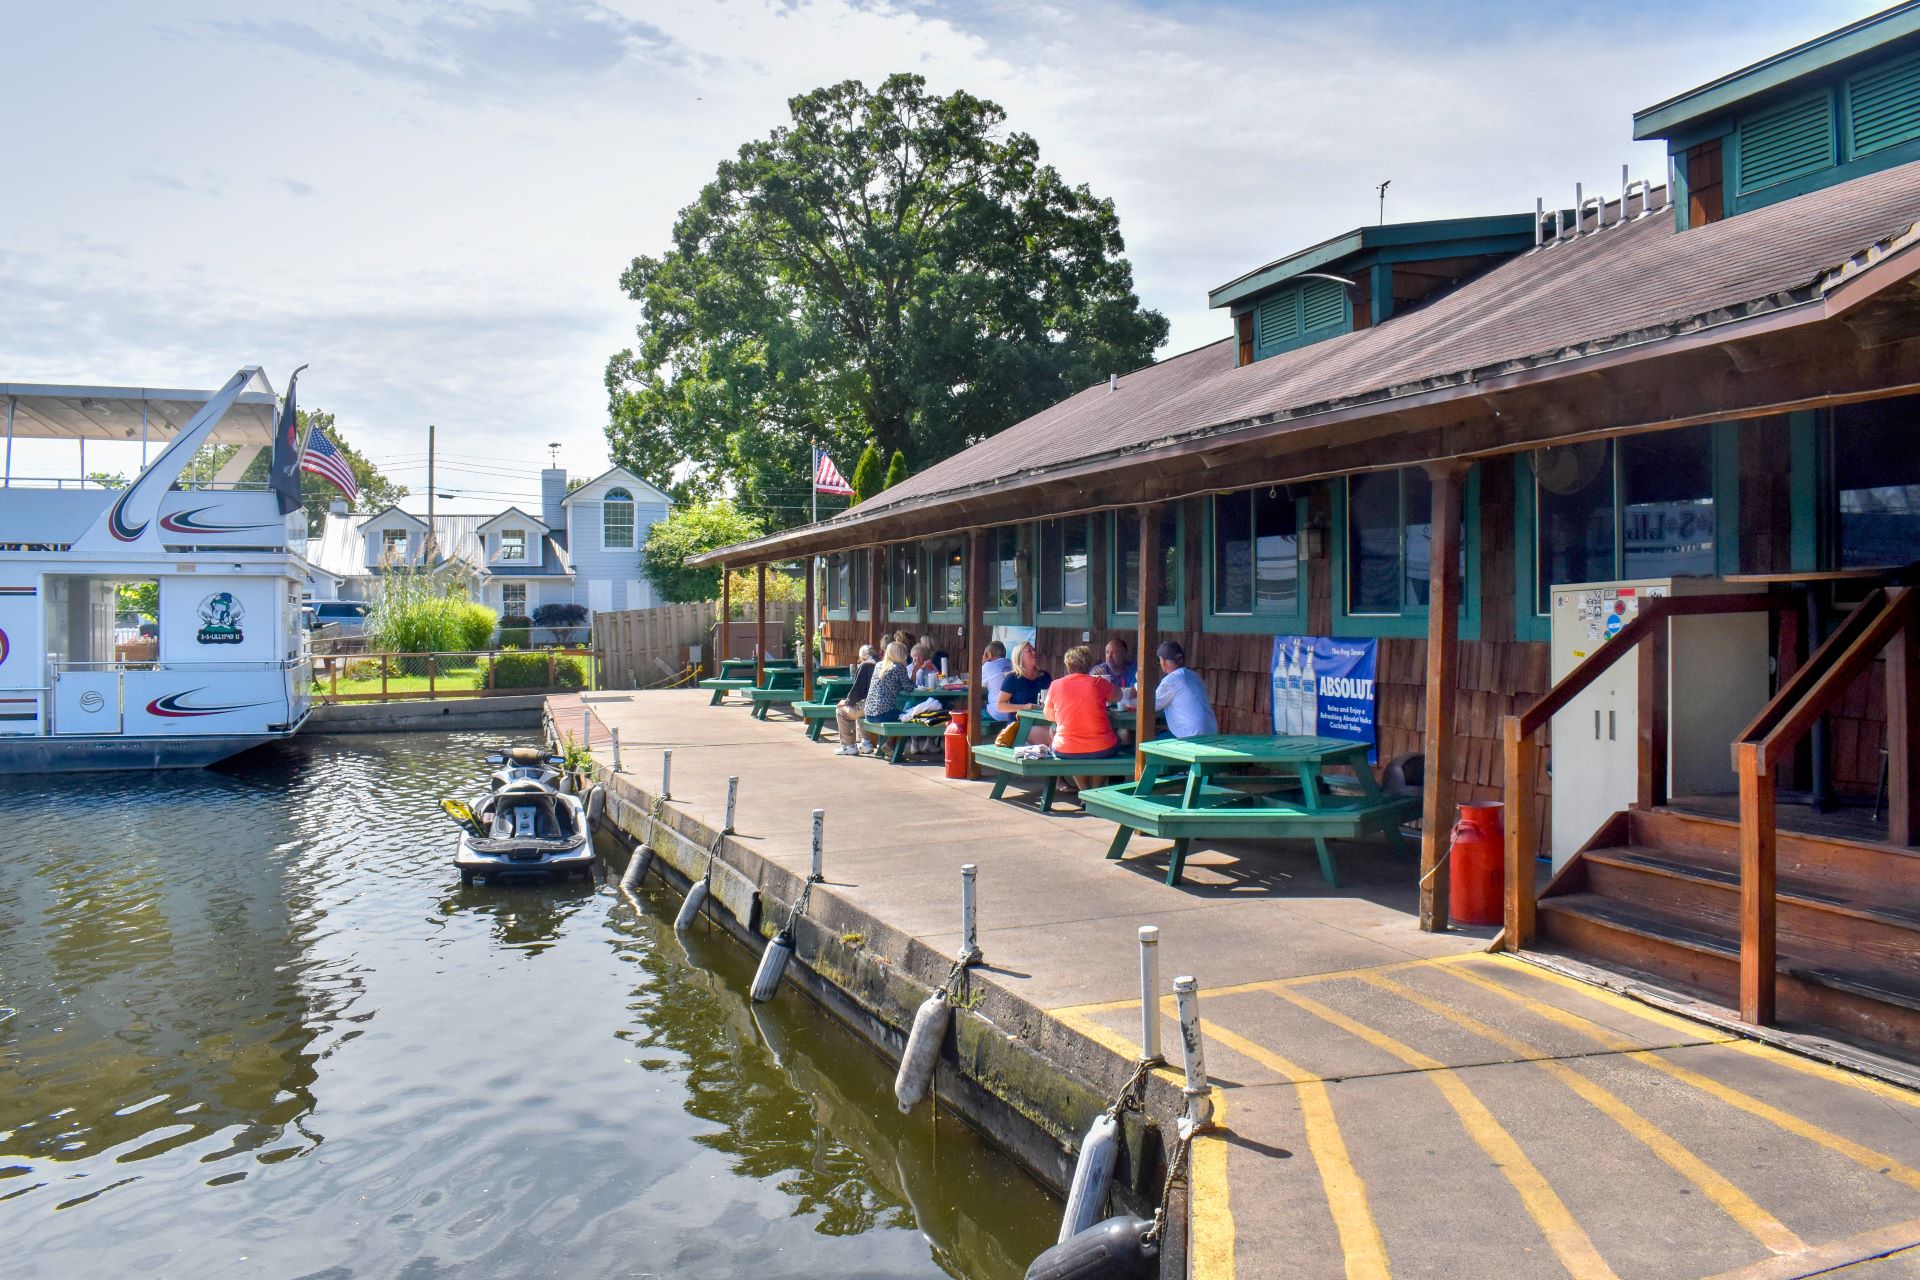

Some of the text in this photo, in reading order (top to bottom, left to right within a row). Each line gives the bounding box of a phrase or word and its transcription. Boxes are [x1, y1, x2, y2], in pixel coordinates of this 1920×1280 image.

[1320, 676, 1373, 700] ABSOLUT.
[1327, 704, 1339, 712] Relax
[1350, 706, 1361, 715] Enjoy
[1320, 712, 1342, 722] Refreshing
[1343, 714, 1359, 722] Absolut
[1330, 721, 1348, 730] Cocktail
